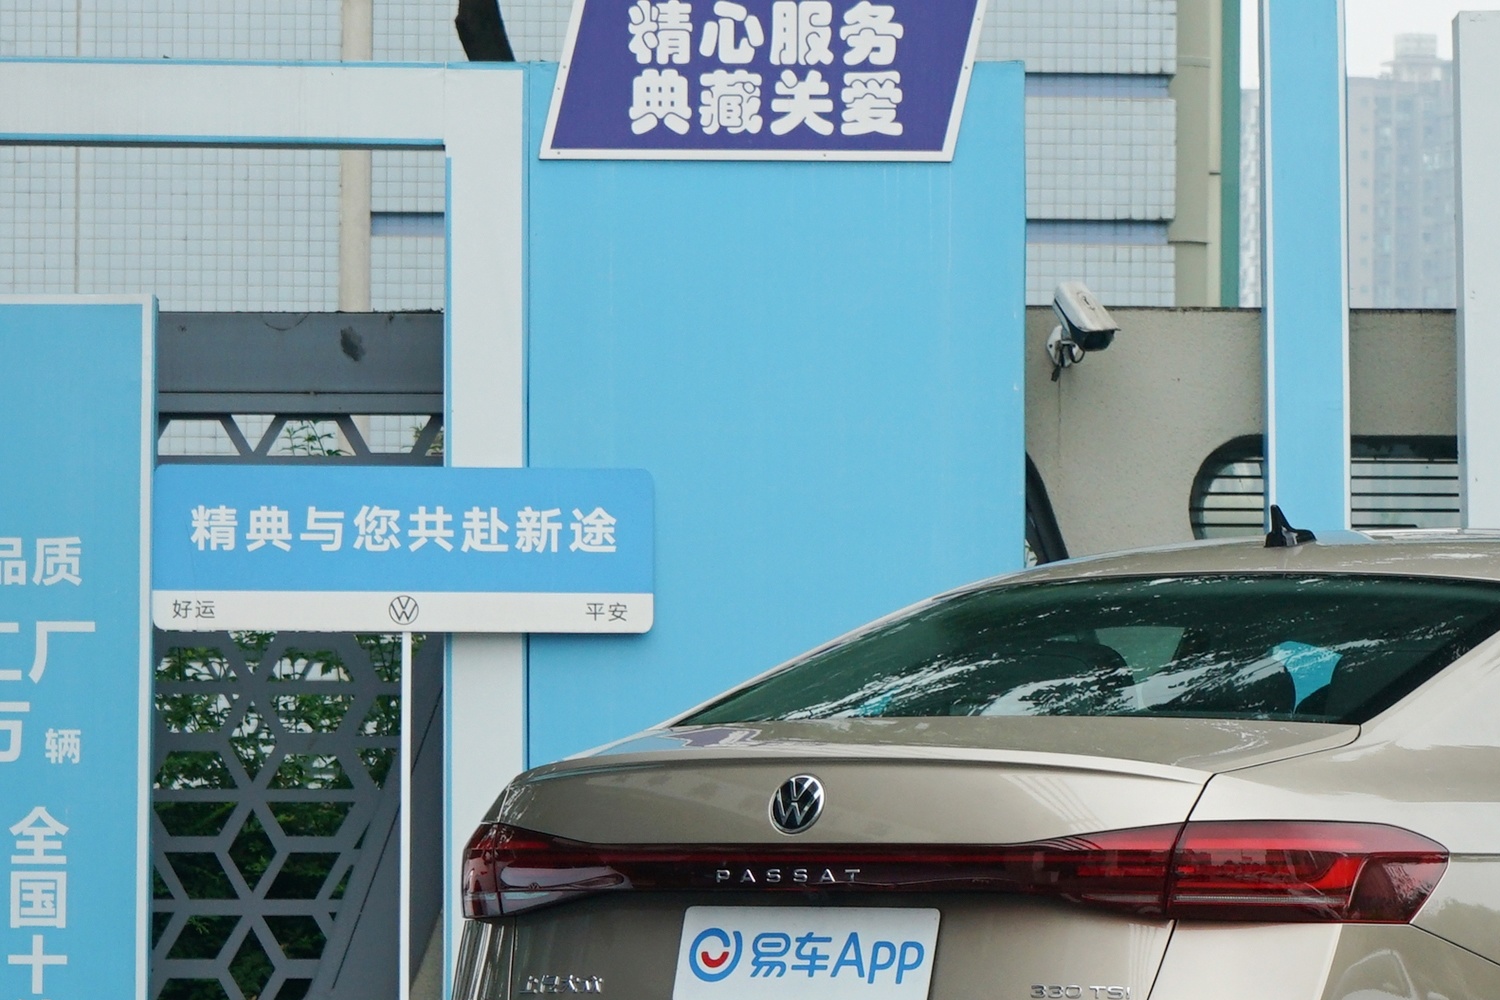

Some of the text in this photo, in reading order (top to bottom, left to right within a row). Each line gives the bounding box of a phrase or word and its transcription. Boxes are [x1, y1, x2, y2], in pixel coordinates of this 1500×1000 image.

[628, 0, 904, 65] 精心服务
[628, 68, 904, 137] 典藏关爱
[190, 505, 619, 555] 精典与您共赴新途
[172, 599, 216, 619] 好运
[585, 601, 628, 622] 平安
[715, 868, 861, 883] PASSAT
[1030, 983, 1131, 1000] 330 TSI
